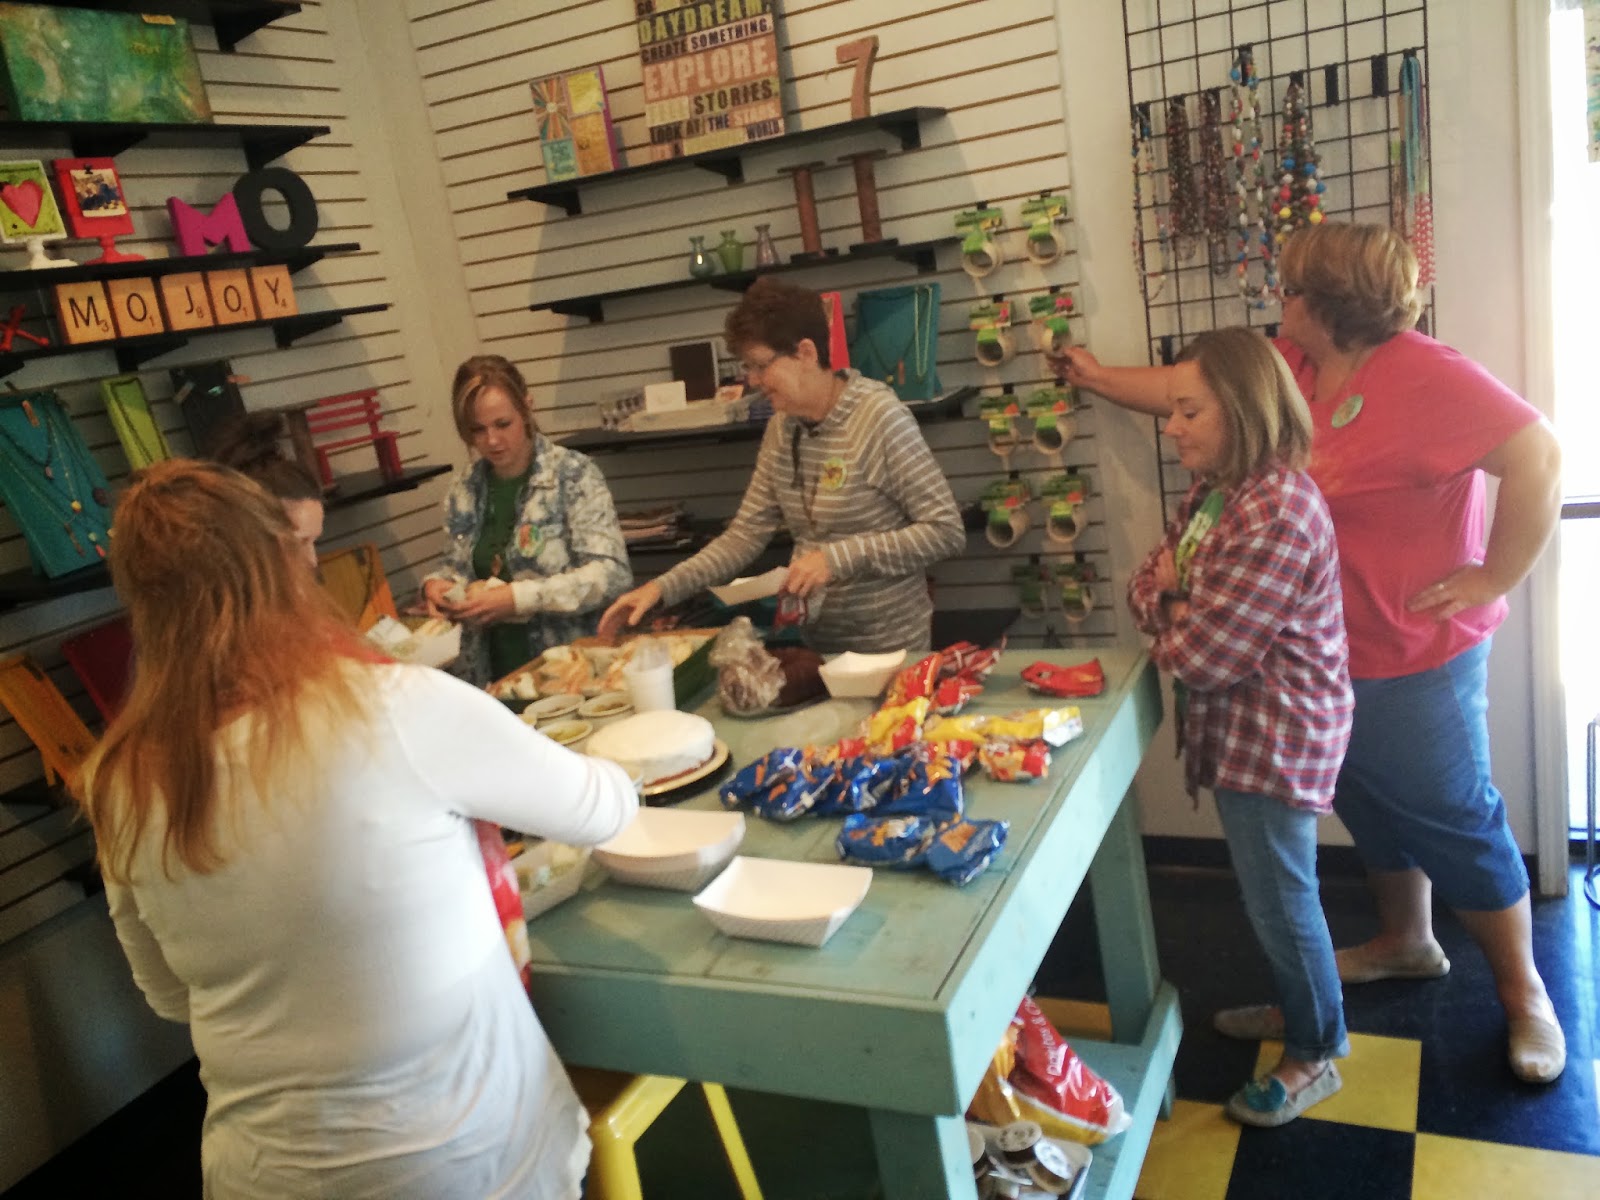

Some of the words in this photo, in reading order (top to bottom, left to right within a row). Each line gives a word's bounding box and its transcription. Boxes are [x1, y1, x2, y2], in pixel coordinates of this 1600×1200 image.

[640, 0, 770, 43] DAYDREAM.
[641, 39, 687, 63] CREATE
[644, 38, 779, 99] EXPLORE.
[693, 78, 780, 115] STORIES.
[708, 114, 730, 132] THE
